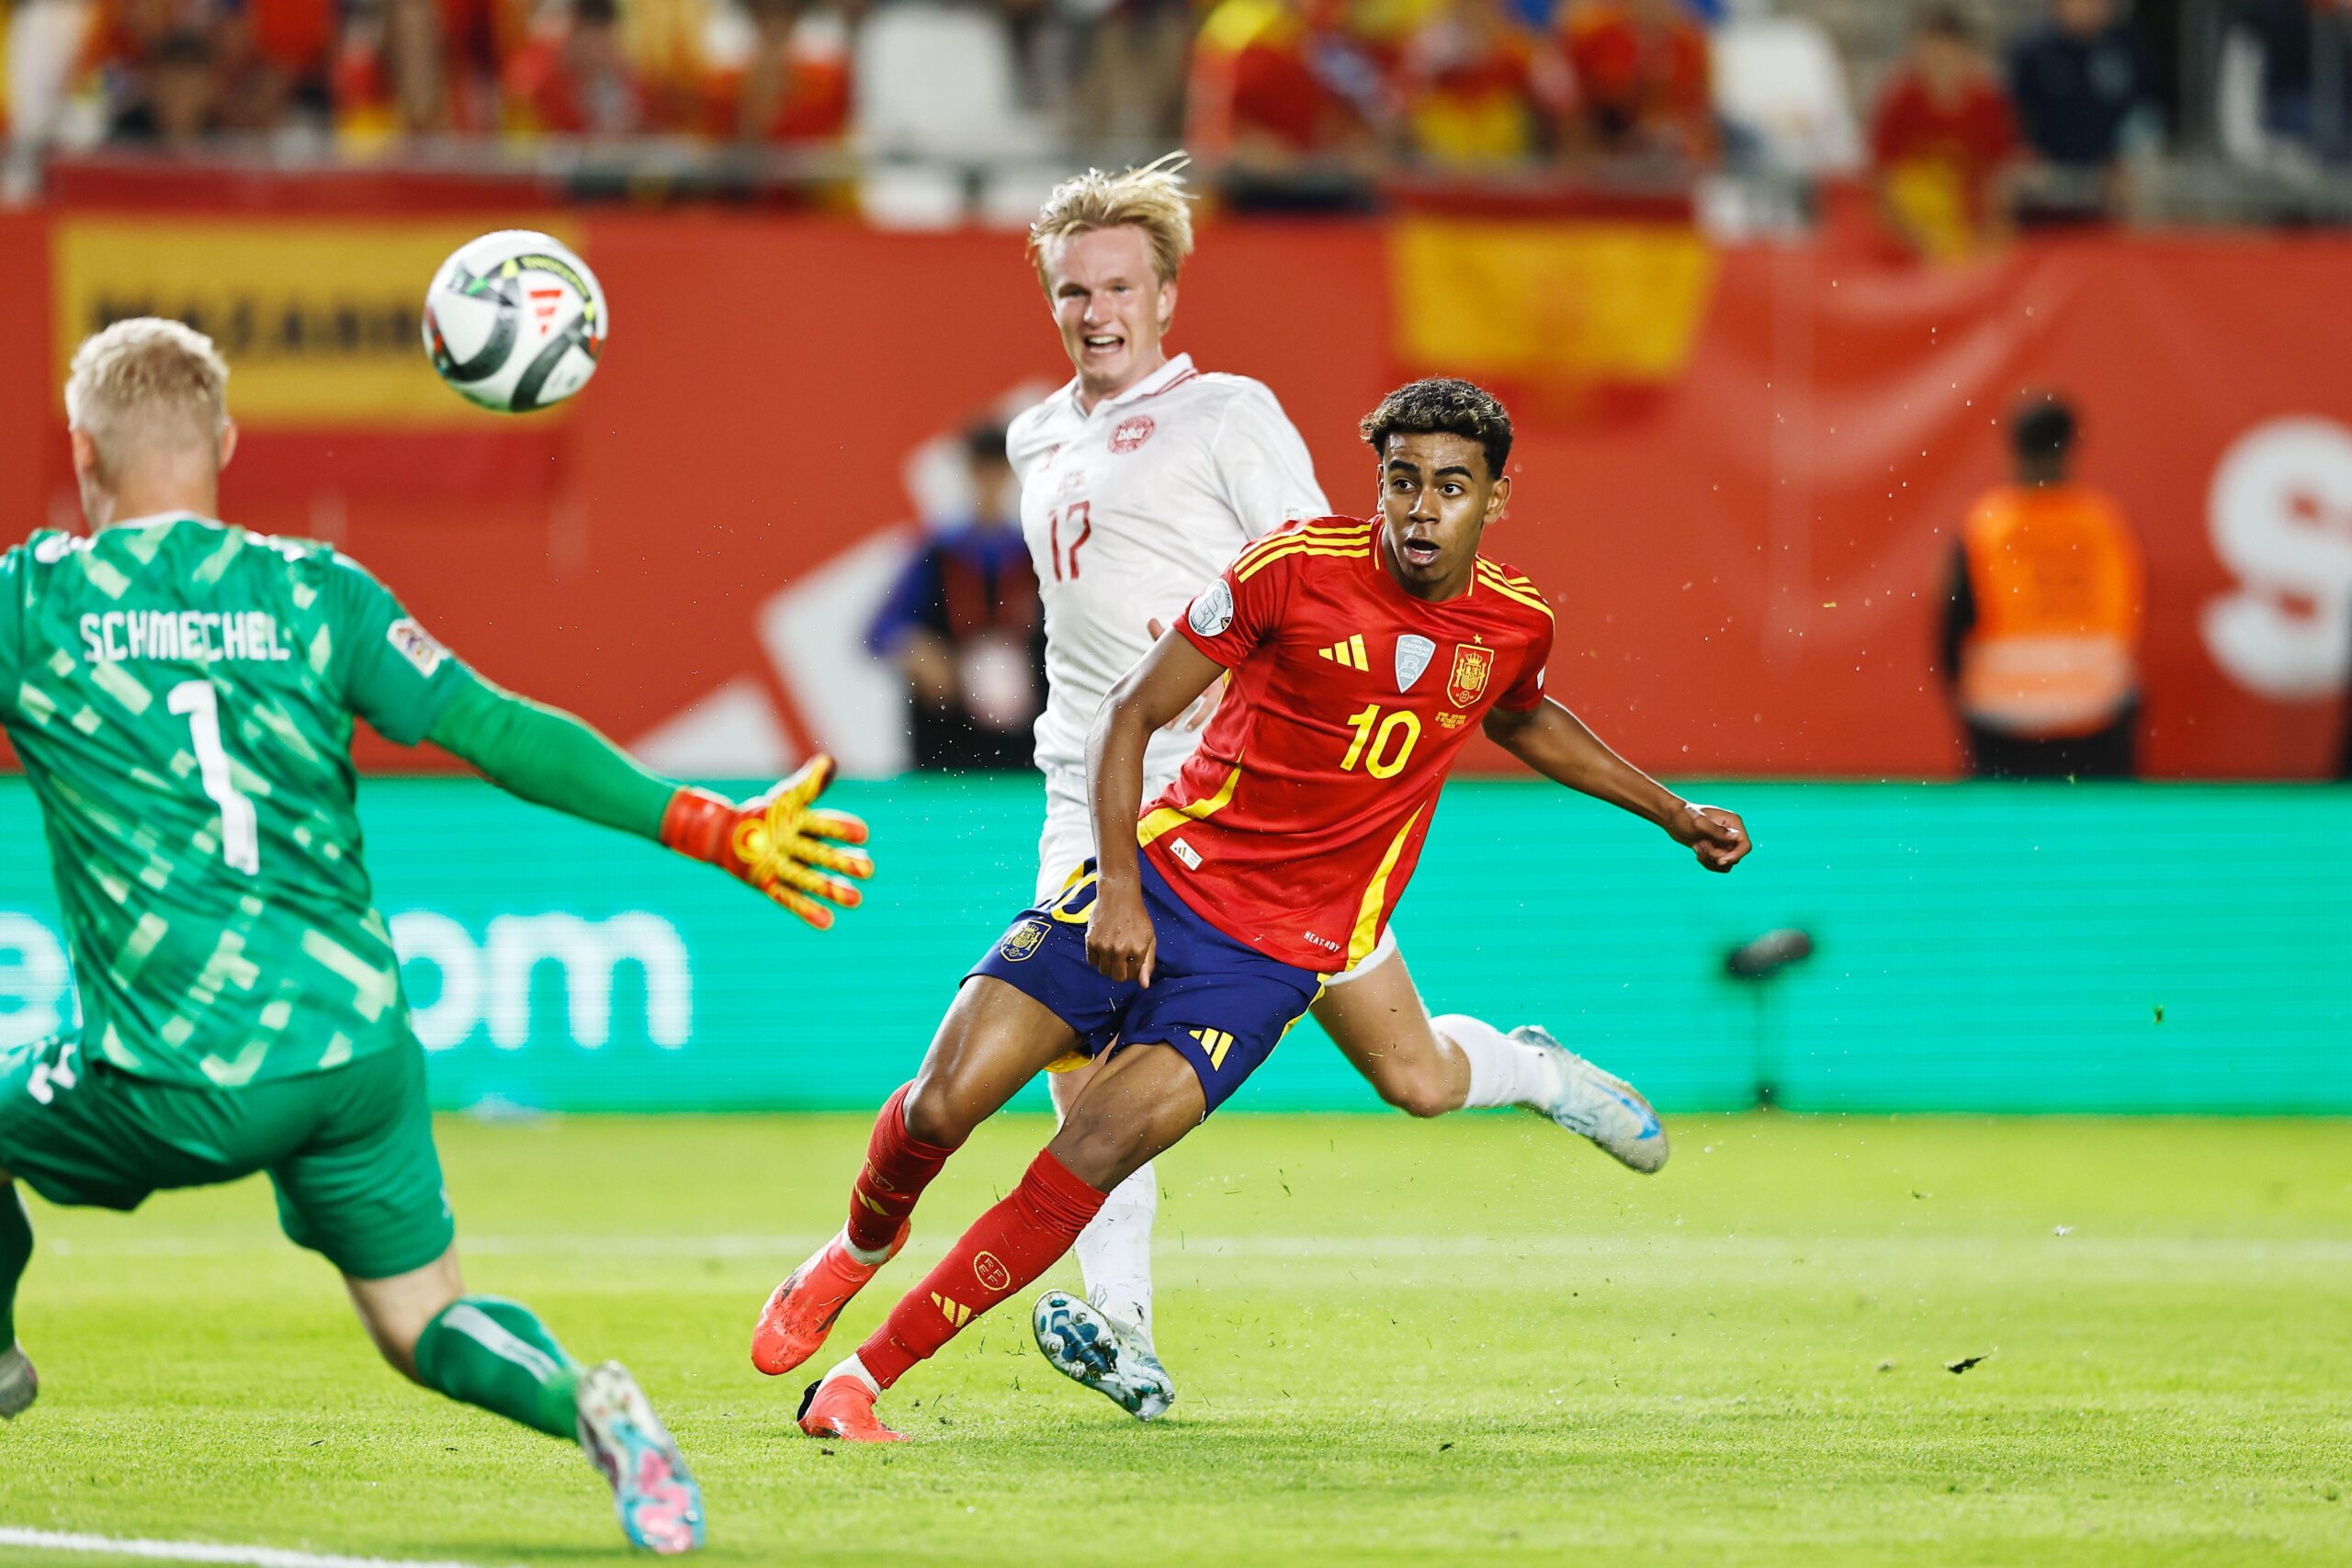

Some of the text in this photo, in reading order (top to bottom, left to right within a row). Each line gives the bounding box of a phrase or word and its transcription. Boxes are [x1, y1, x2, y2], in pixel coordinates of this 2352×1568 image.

[1047, 501, 1091, 582] 17
[167, 680, 260, 876] 1
[1340, 704, 1421, 779] 10
